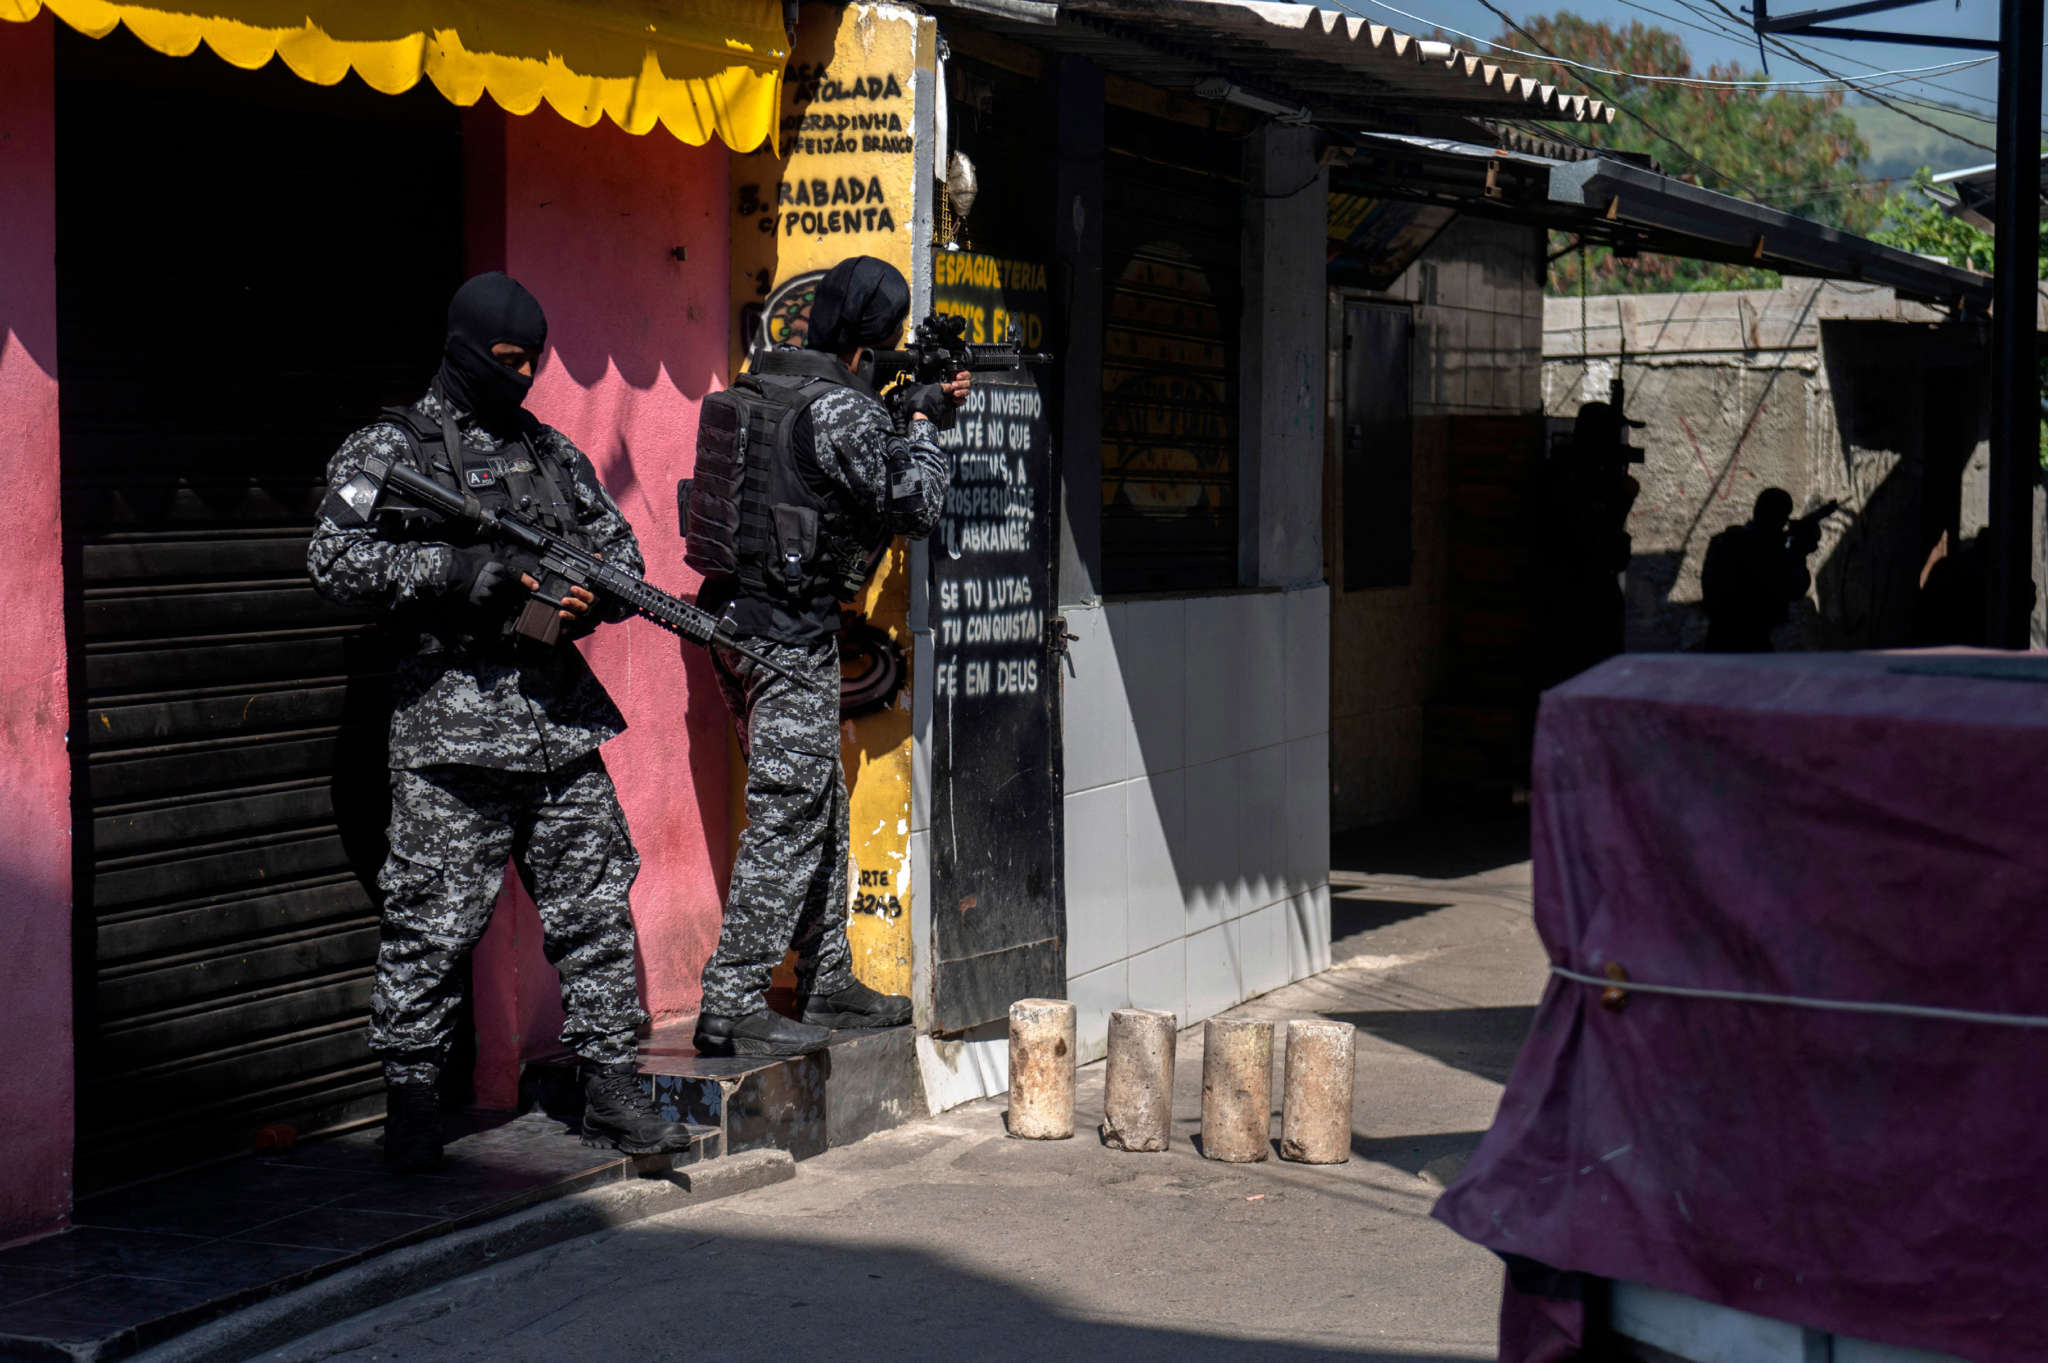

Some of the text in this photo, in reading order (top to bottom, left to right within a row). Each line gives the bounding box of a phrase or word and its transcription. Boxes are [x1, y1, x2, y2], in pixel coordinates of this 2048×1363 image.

[784, 61, 828, 84] ACA
[794, 74, 902, 104] ATOLADA
[781, 113, 902, 132] OBRADINHA
[862, 136, 913, 154] BRANCO
[777, 177, 884, 207] RABADA
[936, 252, 1048, 292] ESPAGUETERIA
[991, 391, 1041, 419] INVESTIDO
[966, 414, 984, 449] FÉ
[988, 420, 1004, 448] NO
[1009, 423, 1031, 451] QUE
[1017, 457, 1027, 486] A
[944, 486, 1035, 521] ROSPERIDADE
[940, 576, 1032, 610] SE TU LUTAS
[942, 610, 1044, 645] TU CONQUISTA!
[937, 655, 1038, 697] FÉ EM DEUS
